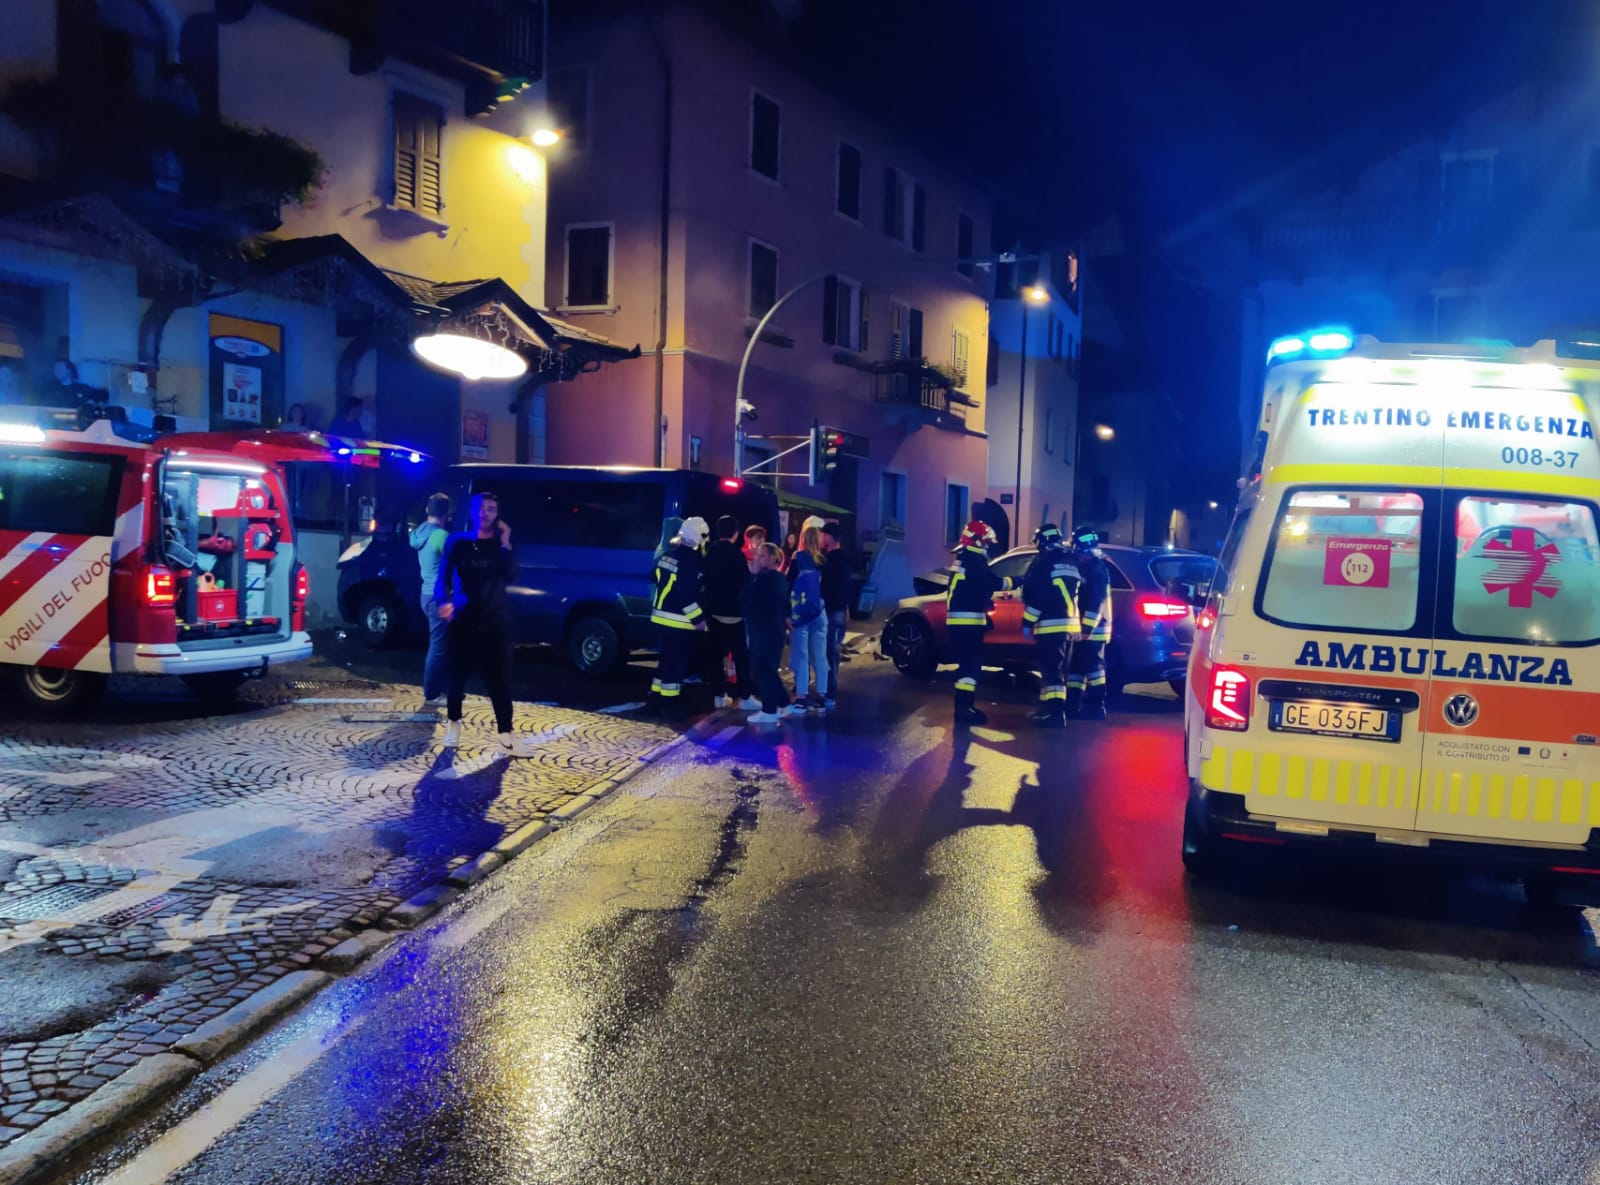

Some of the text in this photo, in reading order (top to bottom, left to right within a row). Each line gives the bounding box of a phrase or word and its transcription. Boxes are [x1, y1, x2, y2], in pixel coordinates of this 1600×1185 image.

[1308, 408, 1595, 440] TRENTINO EMERGENZA
[1501, 446, 1580, 469] 008-37
[1329, 541, 1389, 551] Emergenza
[1352, 564, 1368, 573] 112
[4, 613, 45, 651] VIGILI
[42, 590, 73, 618] DEL
[1295, 640, 1573, 686] AMBULANZA
[1286, 705, 1385, 732] GE 035FJ
[1438, 741, 1510, 753] ACQUISTATO CON
